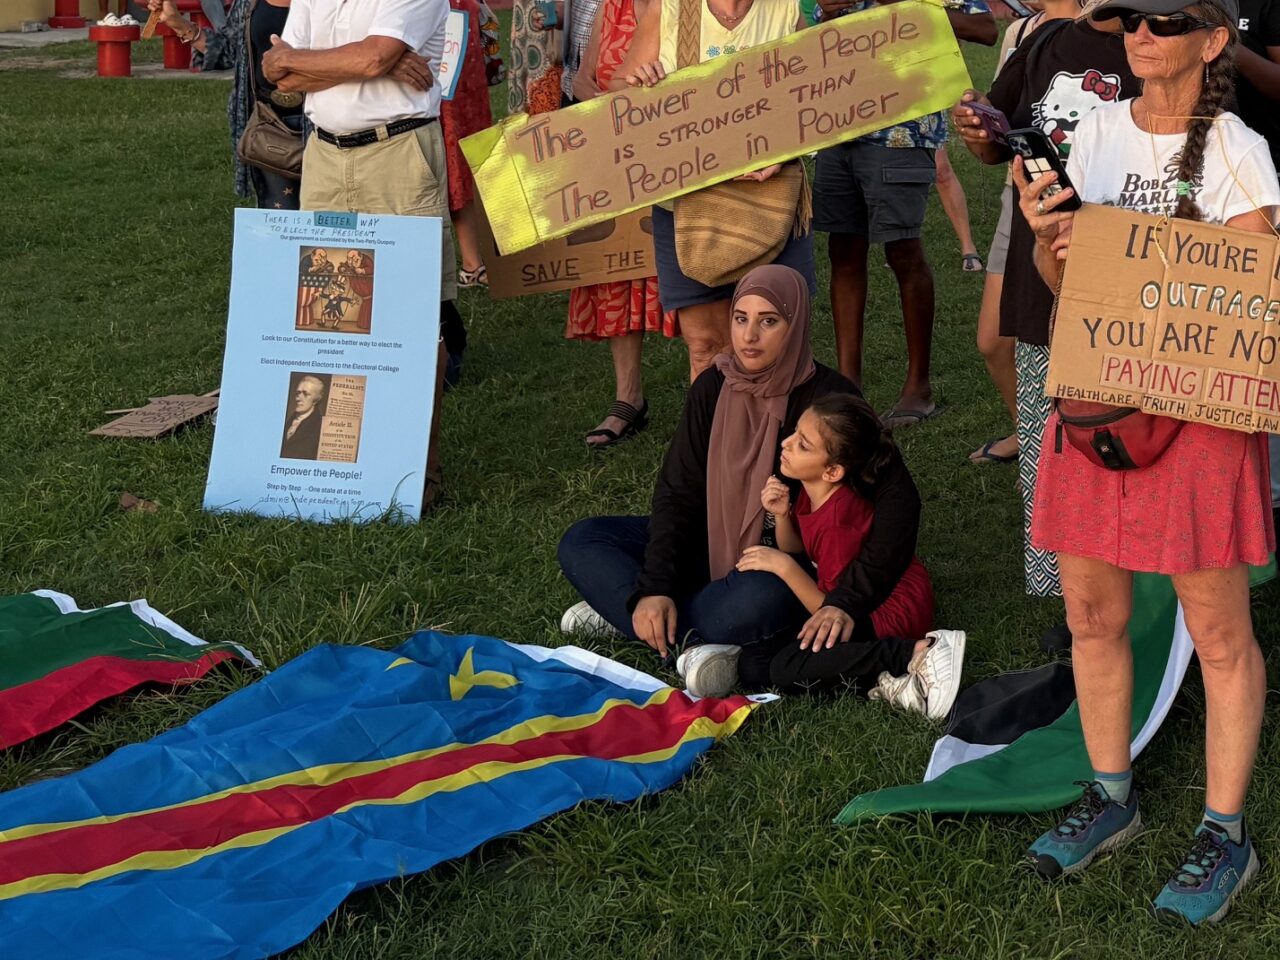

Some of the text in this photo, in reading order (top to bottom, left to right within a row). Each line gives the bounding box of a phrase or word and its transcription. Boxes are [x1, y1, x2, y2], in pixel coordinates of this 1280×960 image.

[517, 12, 920, 164] The Power of the People
[613, 68, 857, 165] IS STRONGER THAN
[546, 90, 899, 223] The People in Power
[1118, 190, 1203, 208] MARLY
[360, 218, 380, 228] WAY
[521, 250, 644, 282] SAVE THE
[1124, 223, 1163, 260] IF
[1174, 230, 1258, 274] YOU'RE
[1082, 317, 1146, 350] YOU
[1158, 321, 1218, 356] ARE
[1104, 356, 1197, 396] PAYING
[1256, 414, 1280, 431] LAW
[266, 482, 280, 491] Step
[281, 484, 287, 492] by
[288, 484, 302, 492] Step
[348, 488, 362, 496] time
[270, 464, 362, 480] Empower the People!
